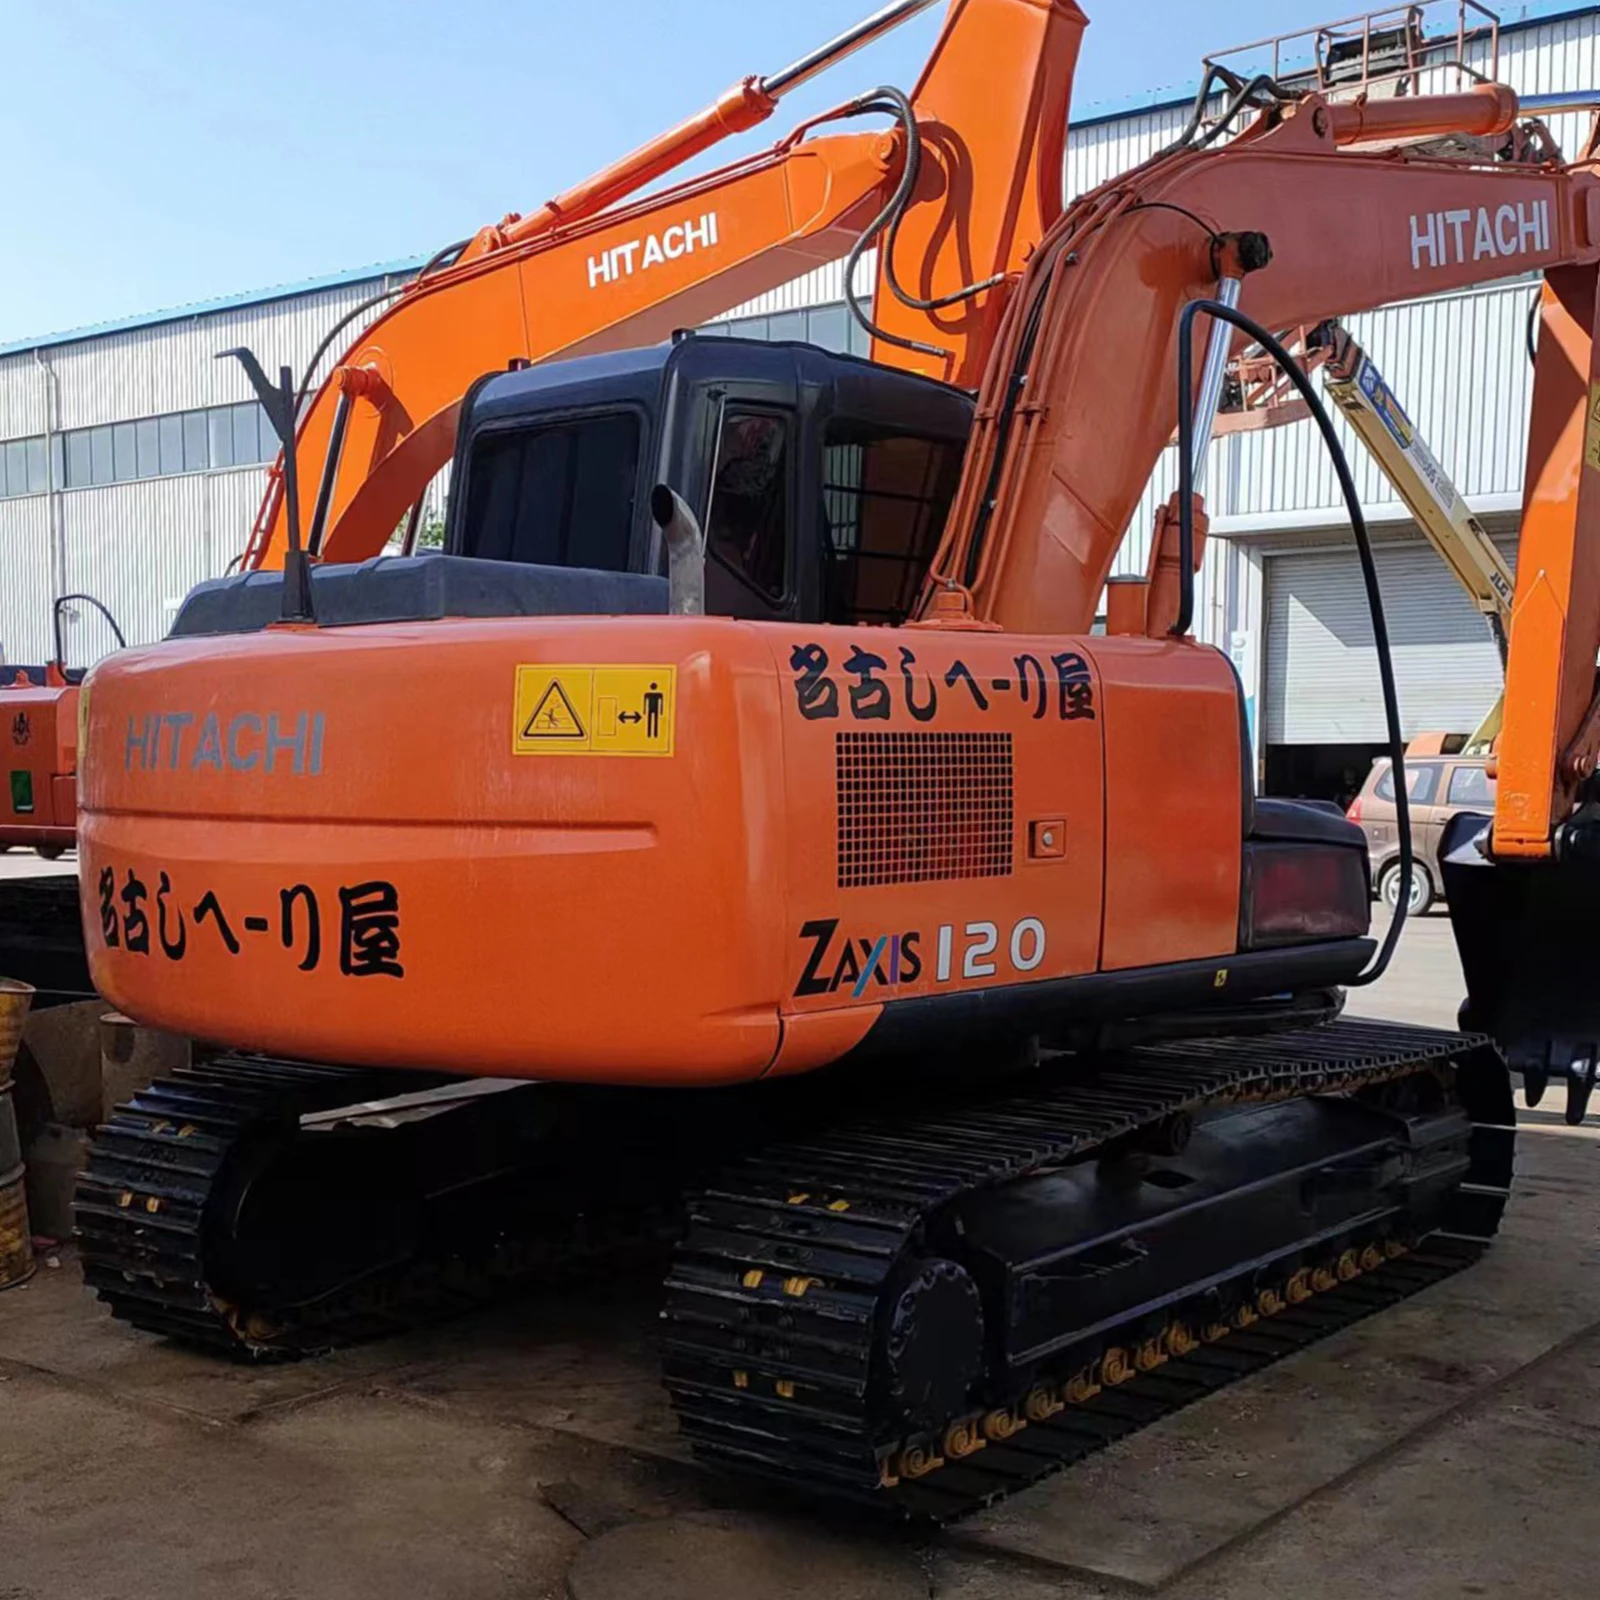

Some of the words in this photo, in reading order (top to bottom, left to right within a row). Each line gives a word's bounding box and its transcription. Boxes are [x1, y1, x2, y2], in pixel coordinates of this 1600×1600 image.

[587, 212, 718, 288] HITACHI
[1409, 200, 1549, 270] HITACHI
[125, 711, 325, 776] HITACHI
[793, 918, 922, 998] ZAXIS
[936, 916, 1046, 982] 120
